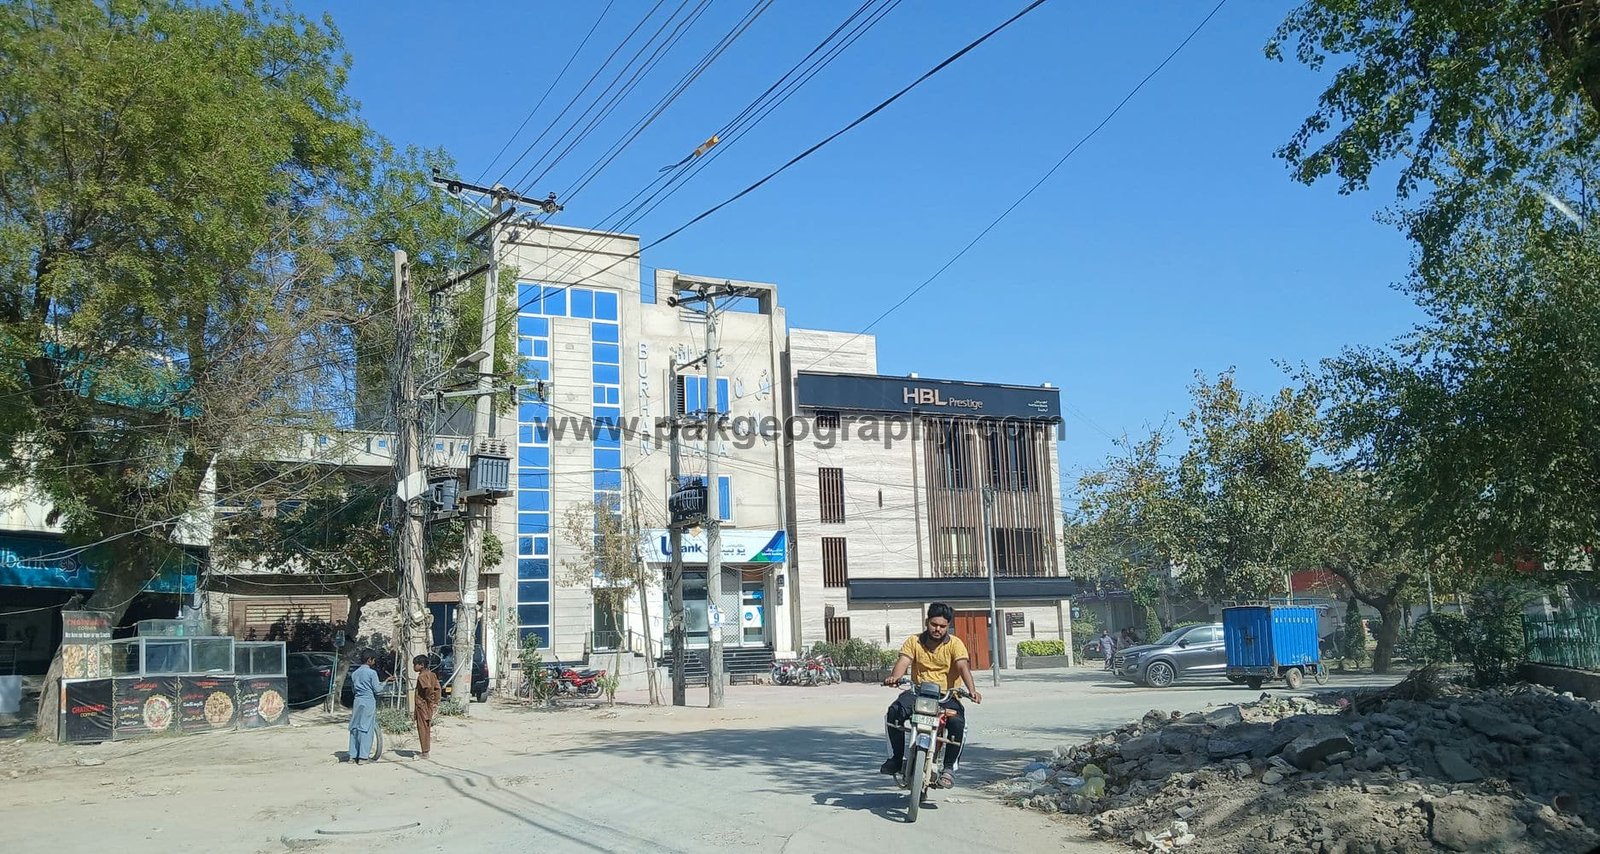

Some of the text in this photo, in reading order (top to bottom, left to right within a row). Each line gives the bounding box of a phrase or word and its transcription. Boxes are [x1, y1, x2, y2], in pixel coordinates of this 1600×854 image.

[638, 340, 651, 457] BURHAN
[903, 387, 984, 410] HBL Prestige
[713, 612, 720, 624] 9
